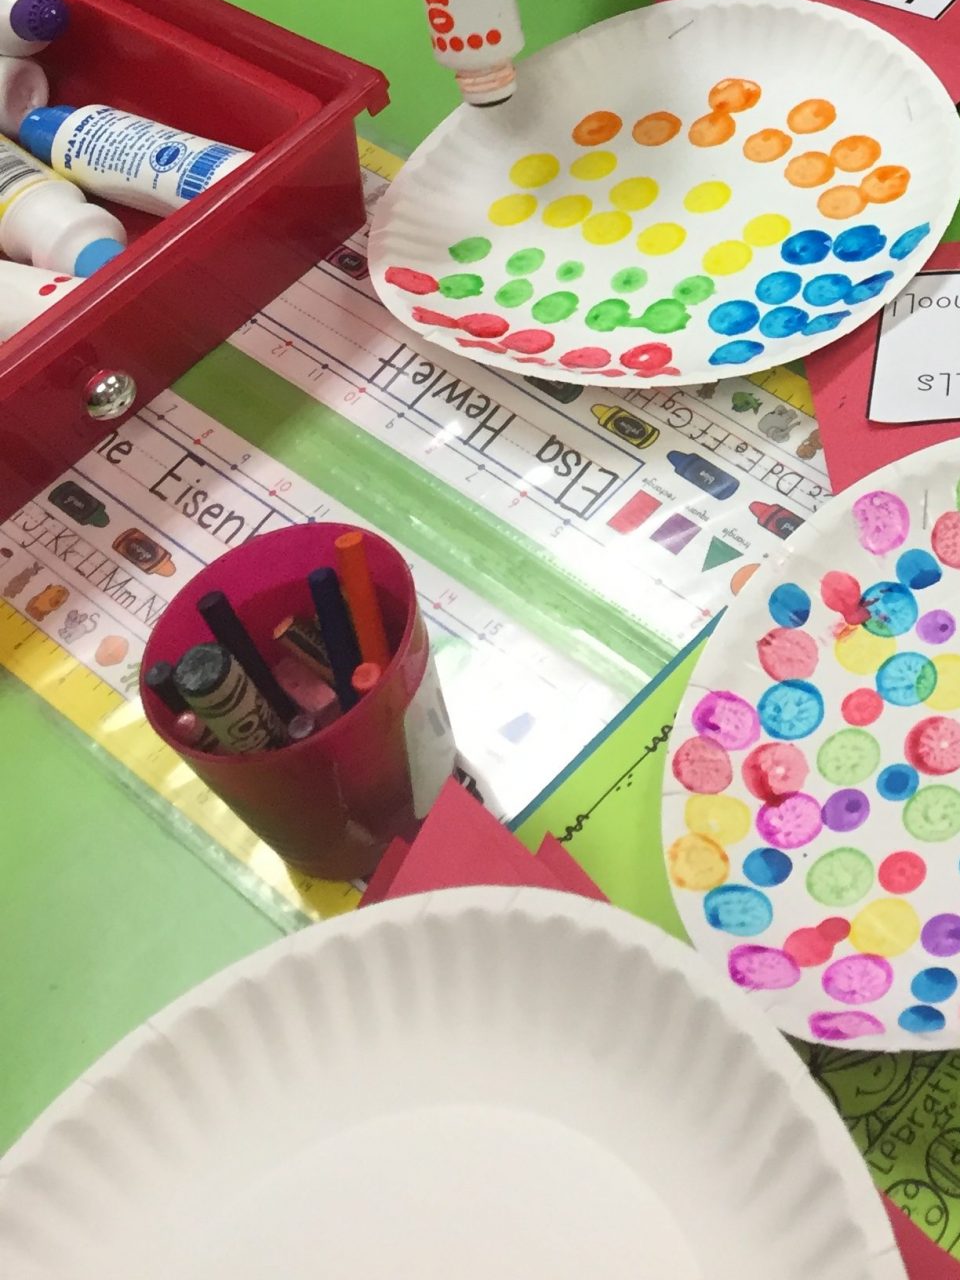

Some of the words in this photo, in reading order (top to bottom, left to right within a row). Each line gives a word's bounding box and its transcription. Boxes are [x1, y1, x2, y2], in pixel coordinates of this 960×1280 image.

[271, 344, 288, 358] 12
[307, 368, 324, 382] 11
[344, 391, 361, 406] 10
[369, 343, 517, 454] Hewlett
[662, 389, 693, 428] Gg
[690, 422, 731, 453] Ff
[735, 441, 766, 474] Ee
[536, 434, 620, 520] Elsa
[642, 477, 677, 502] rectangle
[761, 463, 804, 496] Dd
[275, 478, 293, 492] 10
[314, 504, 330, 518] 11
[438, 588, 459, 606] 14
[721, 528, 751, 549] triangle
[52, 528, 80, 562] Kk
[102, 567, 138, 609] Mm
[137, 594, 168, 626] N
